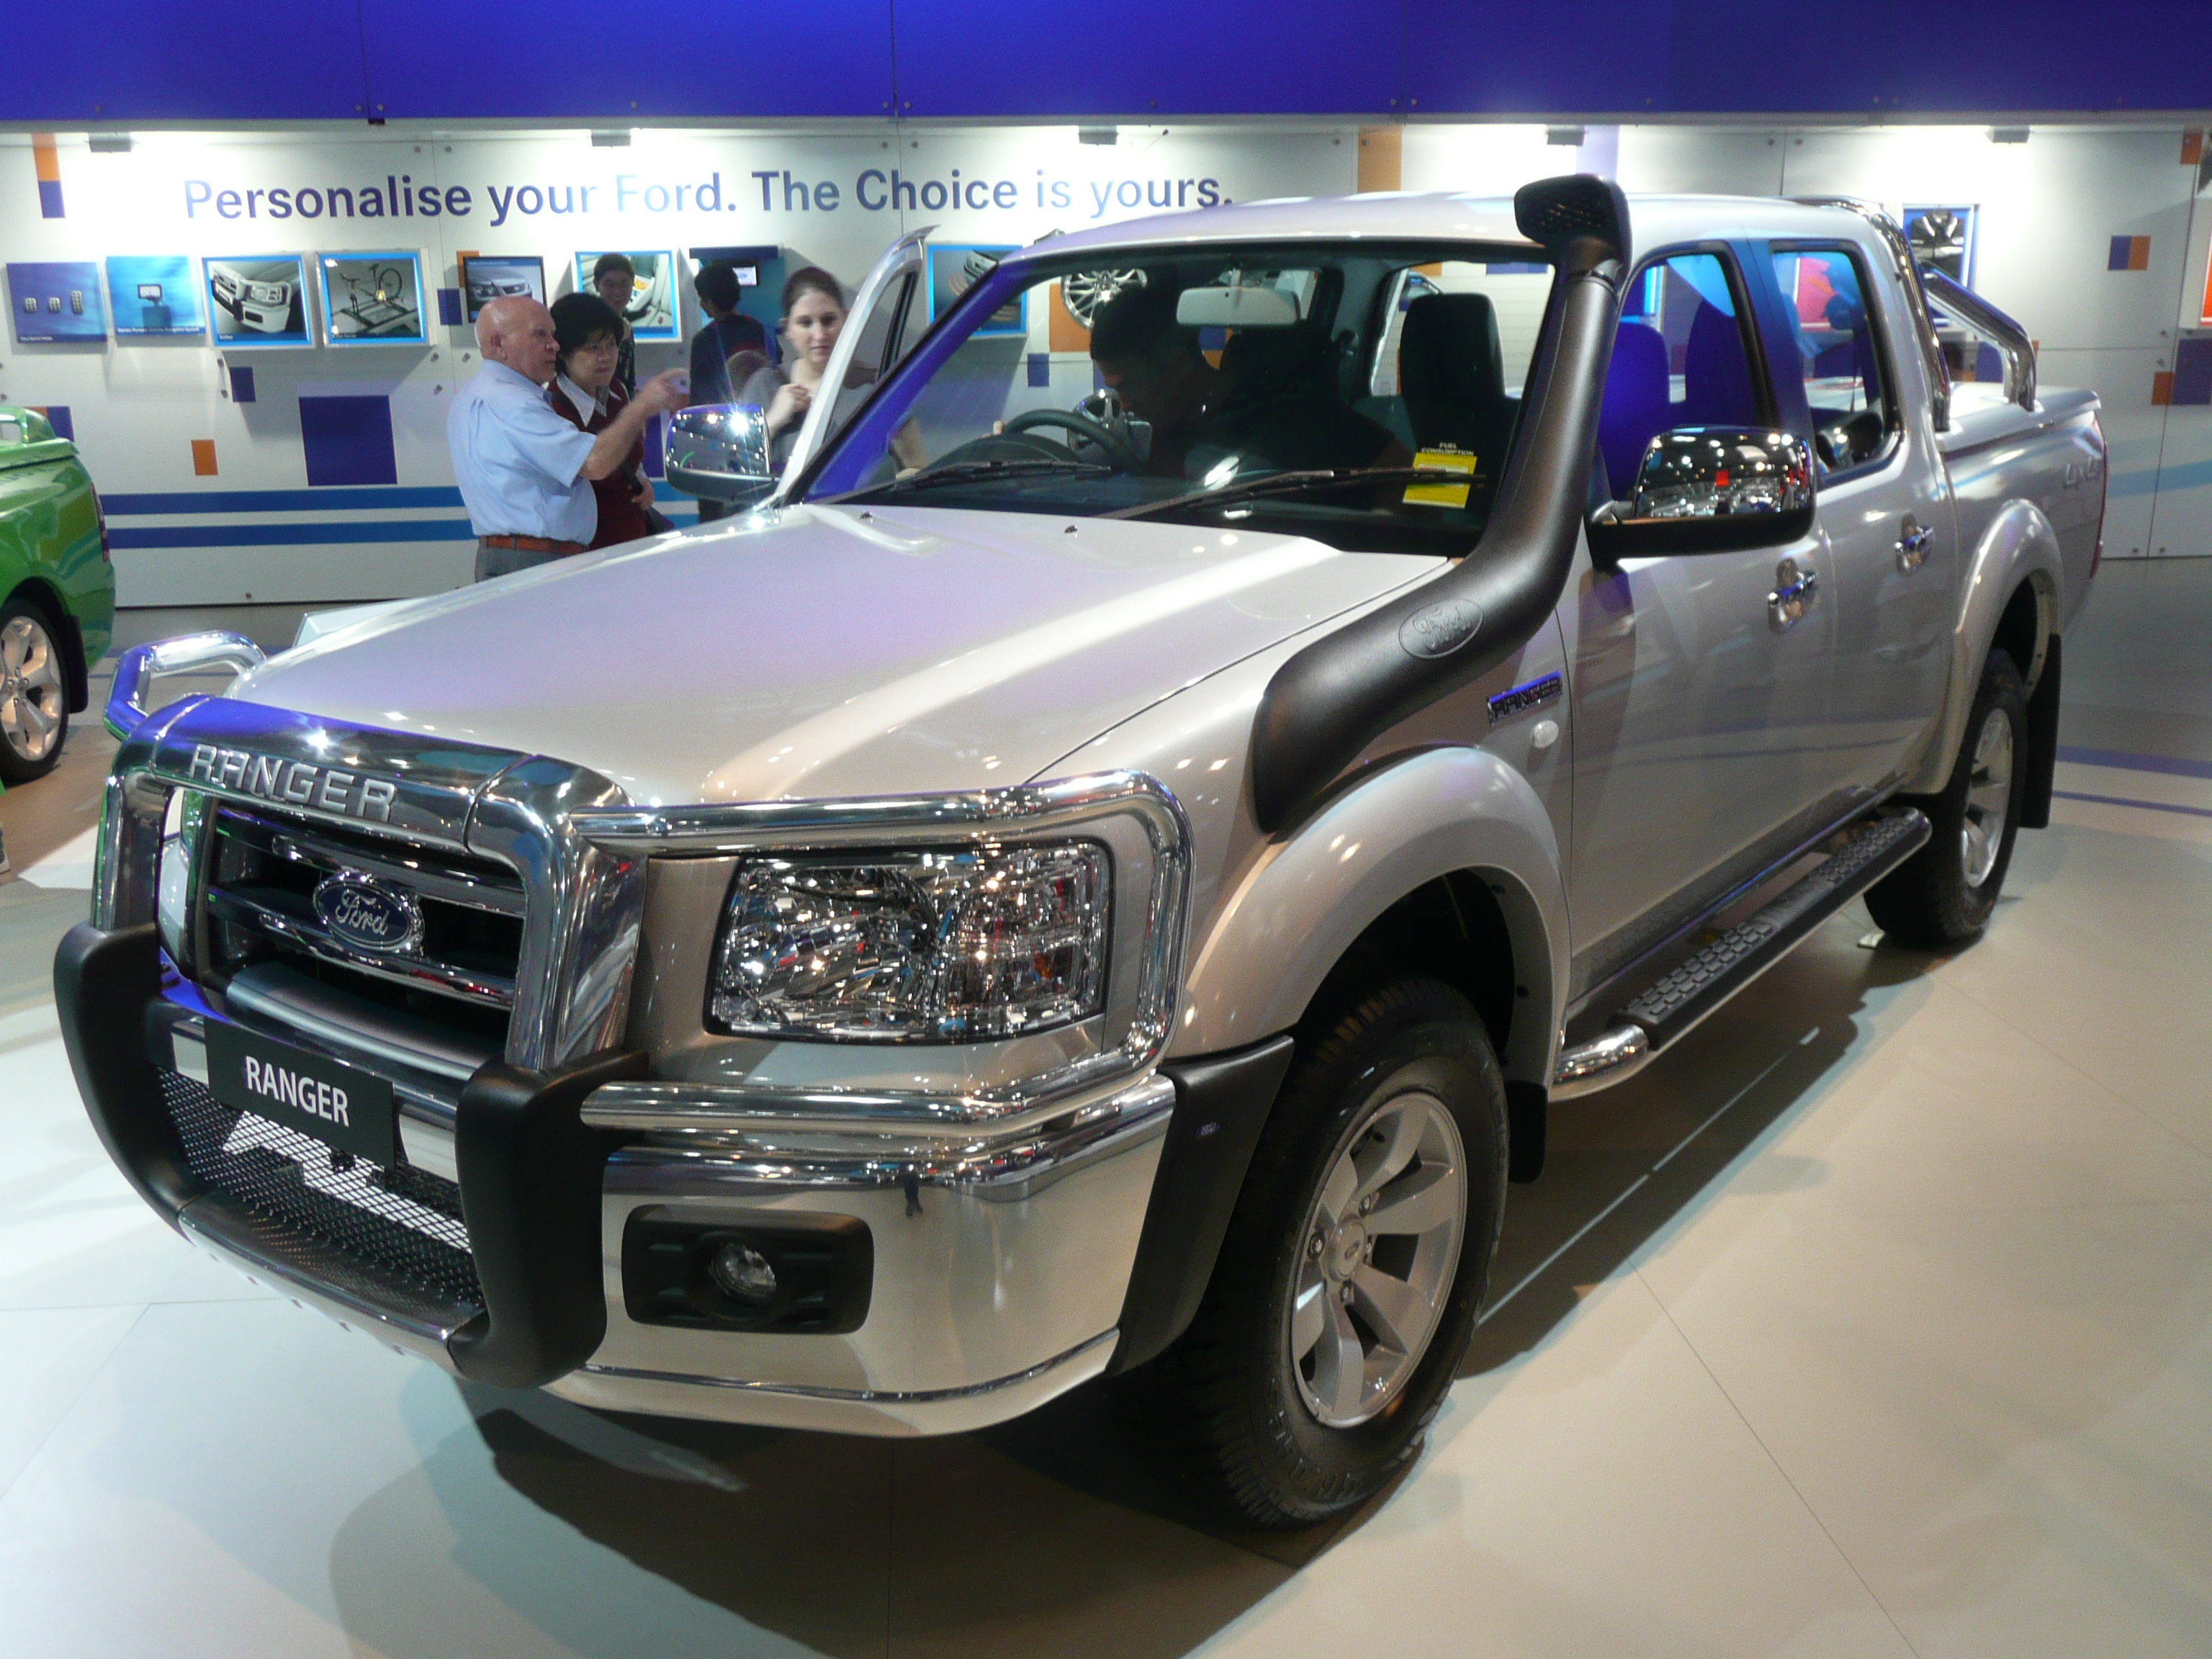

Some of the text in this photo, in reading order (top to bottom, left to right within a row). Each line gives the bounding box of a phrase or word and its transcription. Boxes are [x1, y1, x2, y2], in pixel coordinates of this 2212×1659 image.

[184, 168, 1233, 227] Personalise your Ford. The Choice is yours.
[1421, 447, 1475, 457] CONSUMPTION
[1412, 605, 1471, 650] Ford
[189, 743, 397, 823] RANGER
[335, 889, 391, 936] Ford
[245, 1056, 349, 1128] RANGER
